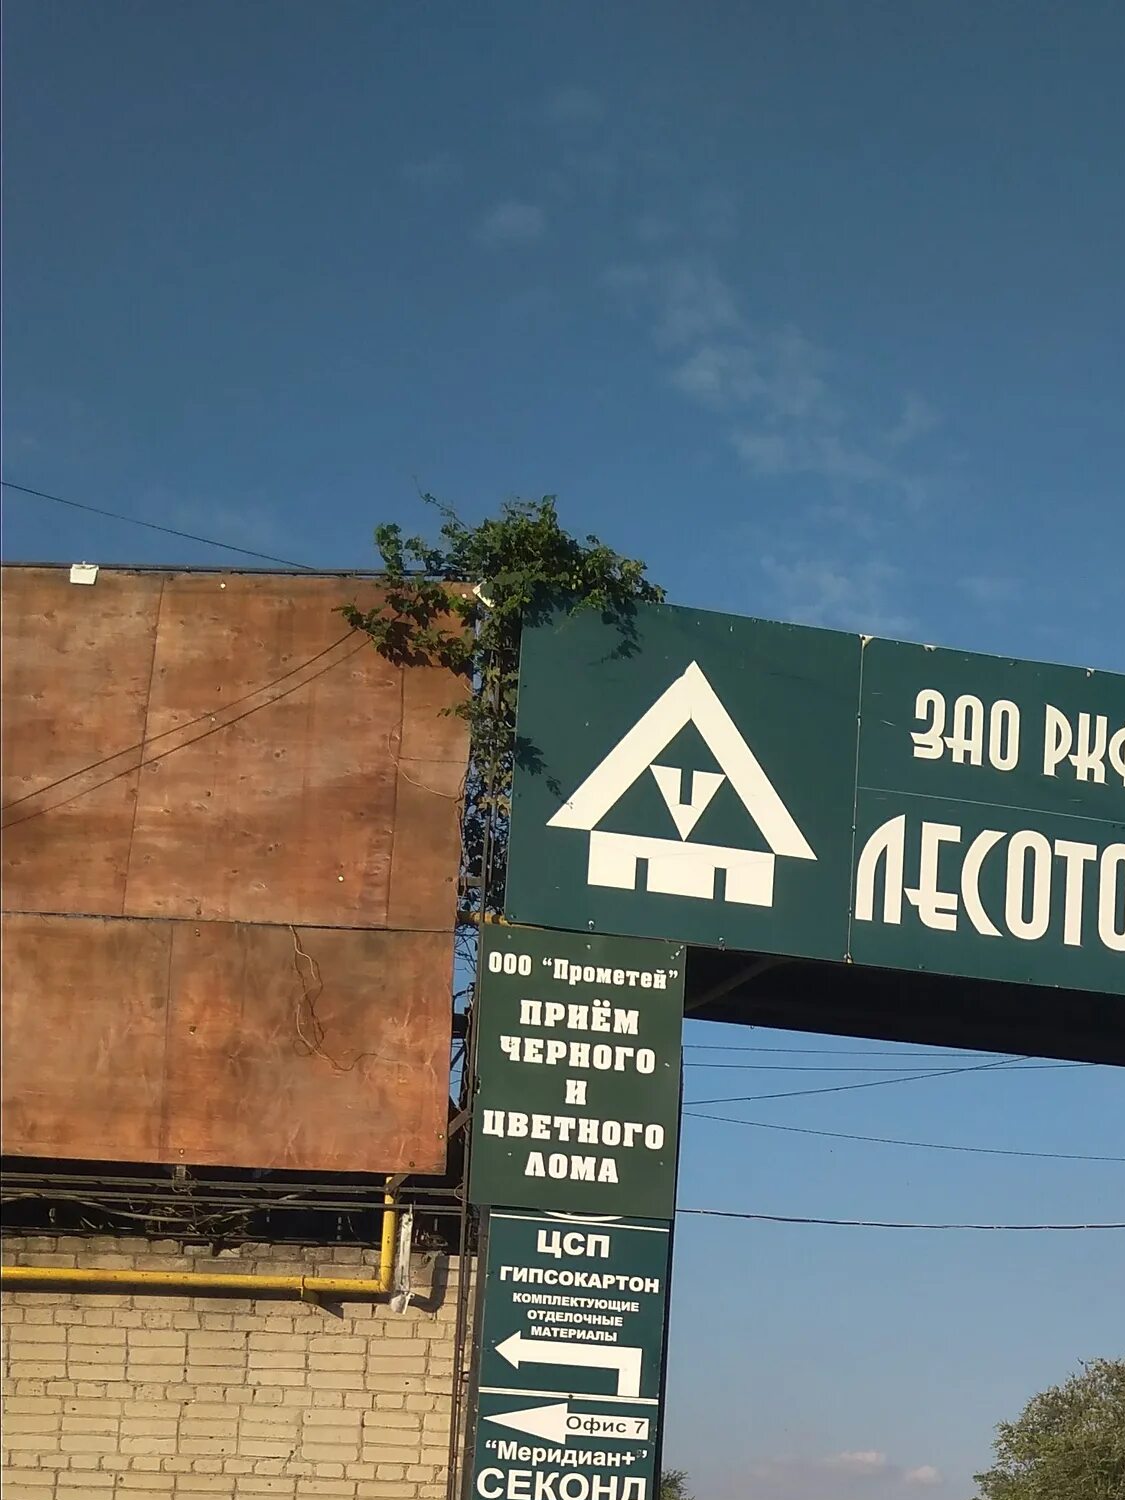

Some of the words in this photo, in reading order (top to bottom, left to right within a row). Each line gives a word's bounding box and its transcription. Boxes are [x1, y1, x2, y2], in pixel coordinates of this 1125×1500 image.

[910, 689, 1020, 772] ЗАО
[488, 951, 532, 976] ООО
[542, 957, 679, 990] “Прометей”
[520, 999, 640, 1035] ПРИЁМ
[500, 1035, 656, 1075] ЧЕРНОГО
[565, 1079, 587, 1105] И
[482, 1109, 665, 1150] ЦВЕТНОГО
[524, 1151, 619, 1183] ЛОМА
[536, 1229, 610, 1258] ЦСП
[500, 1265, 660, 1294] ГИПСОКАРТОН
[513, 1292, 640, 1312] КОМПЛЕКТУЮЩИЕ
[527, 1309, 623, 1327] ОТДЕЛОЧНЫЕ
[530, 1326, 617, 1342] МАТЕРИАЛЫ
[566, 1415, 628, 1435] Офис
[634, 1421, 646, 1434] 7
